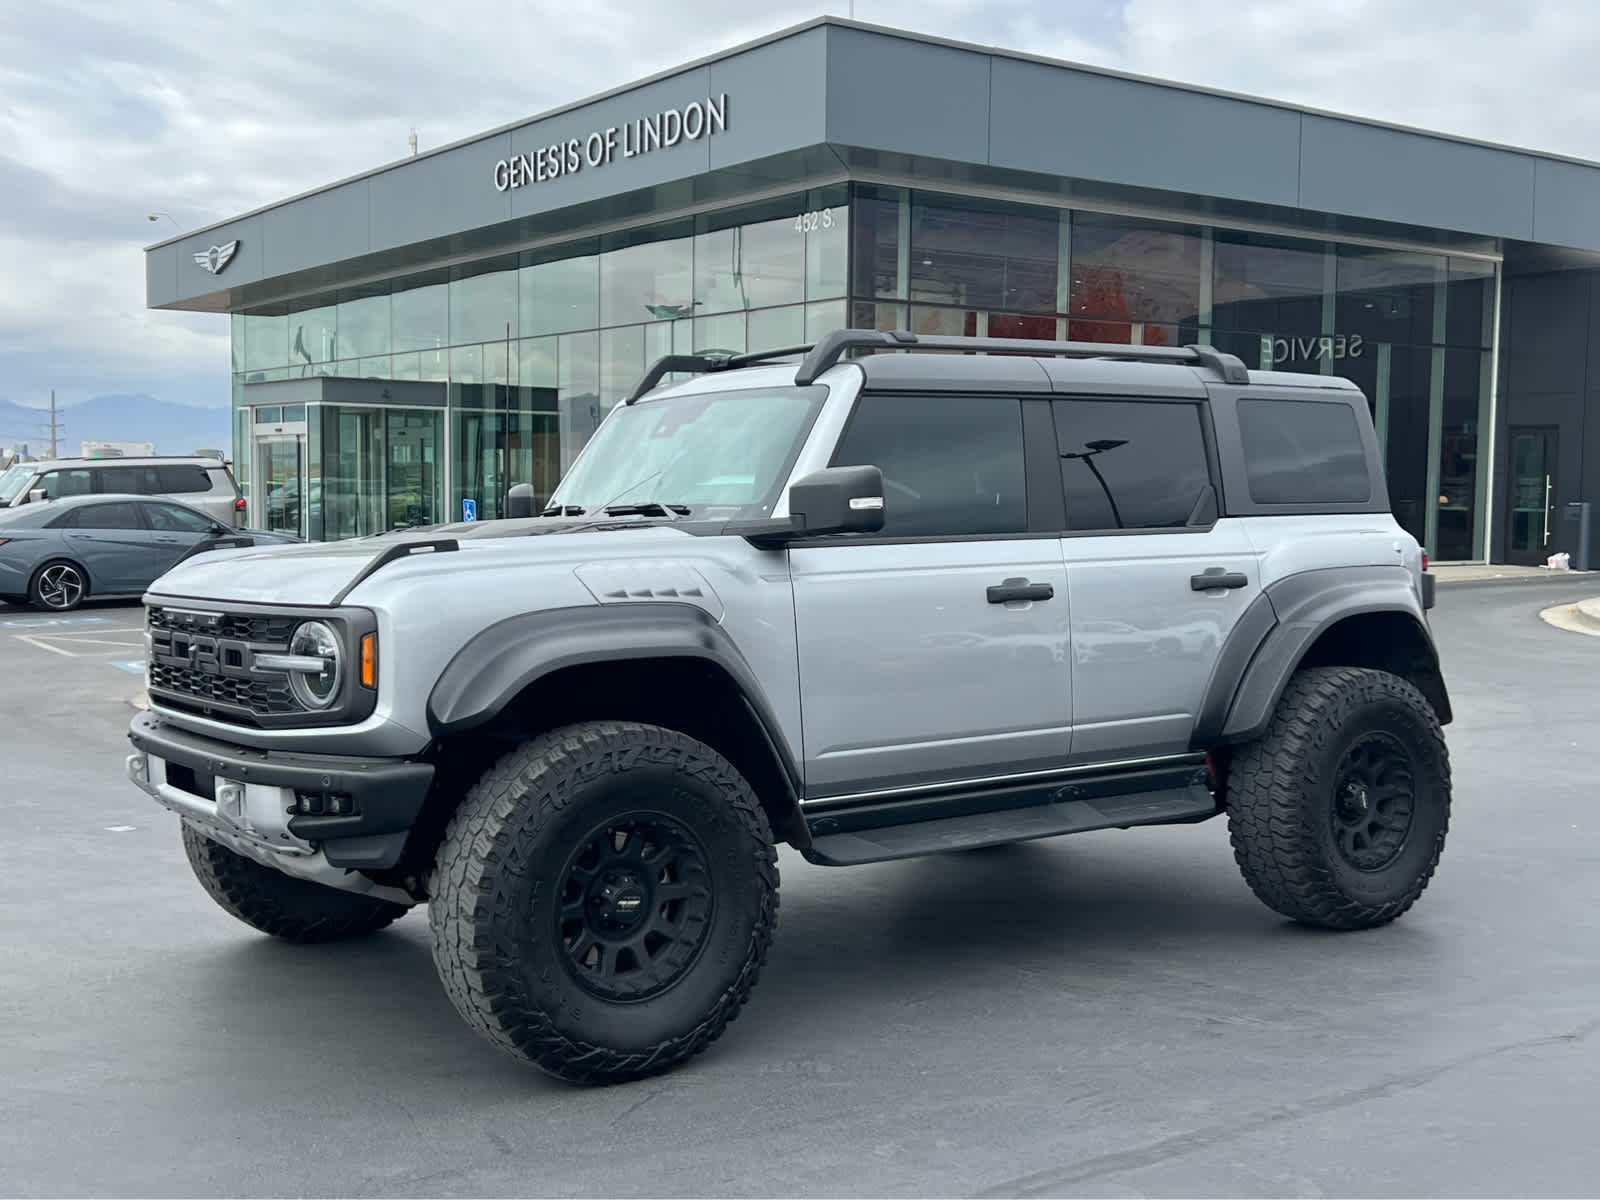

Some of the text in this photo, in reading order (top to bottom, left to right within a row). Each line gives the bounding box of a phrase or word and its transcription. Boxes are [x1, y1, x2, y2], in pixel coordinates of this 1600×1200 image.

[494, 93, 727, 192] GENESIS OF LINDON
